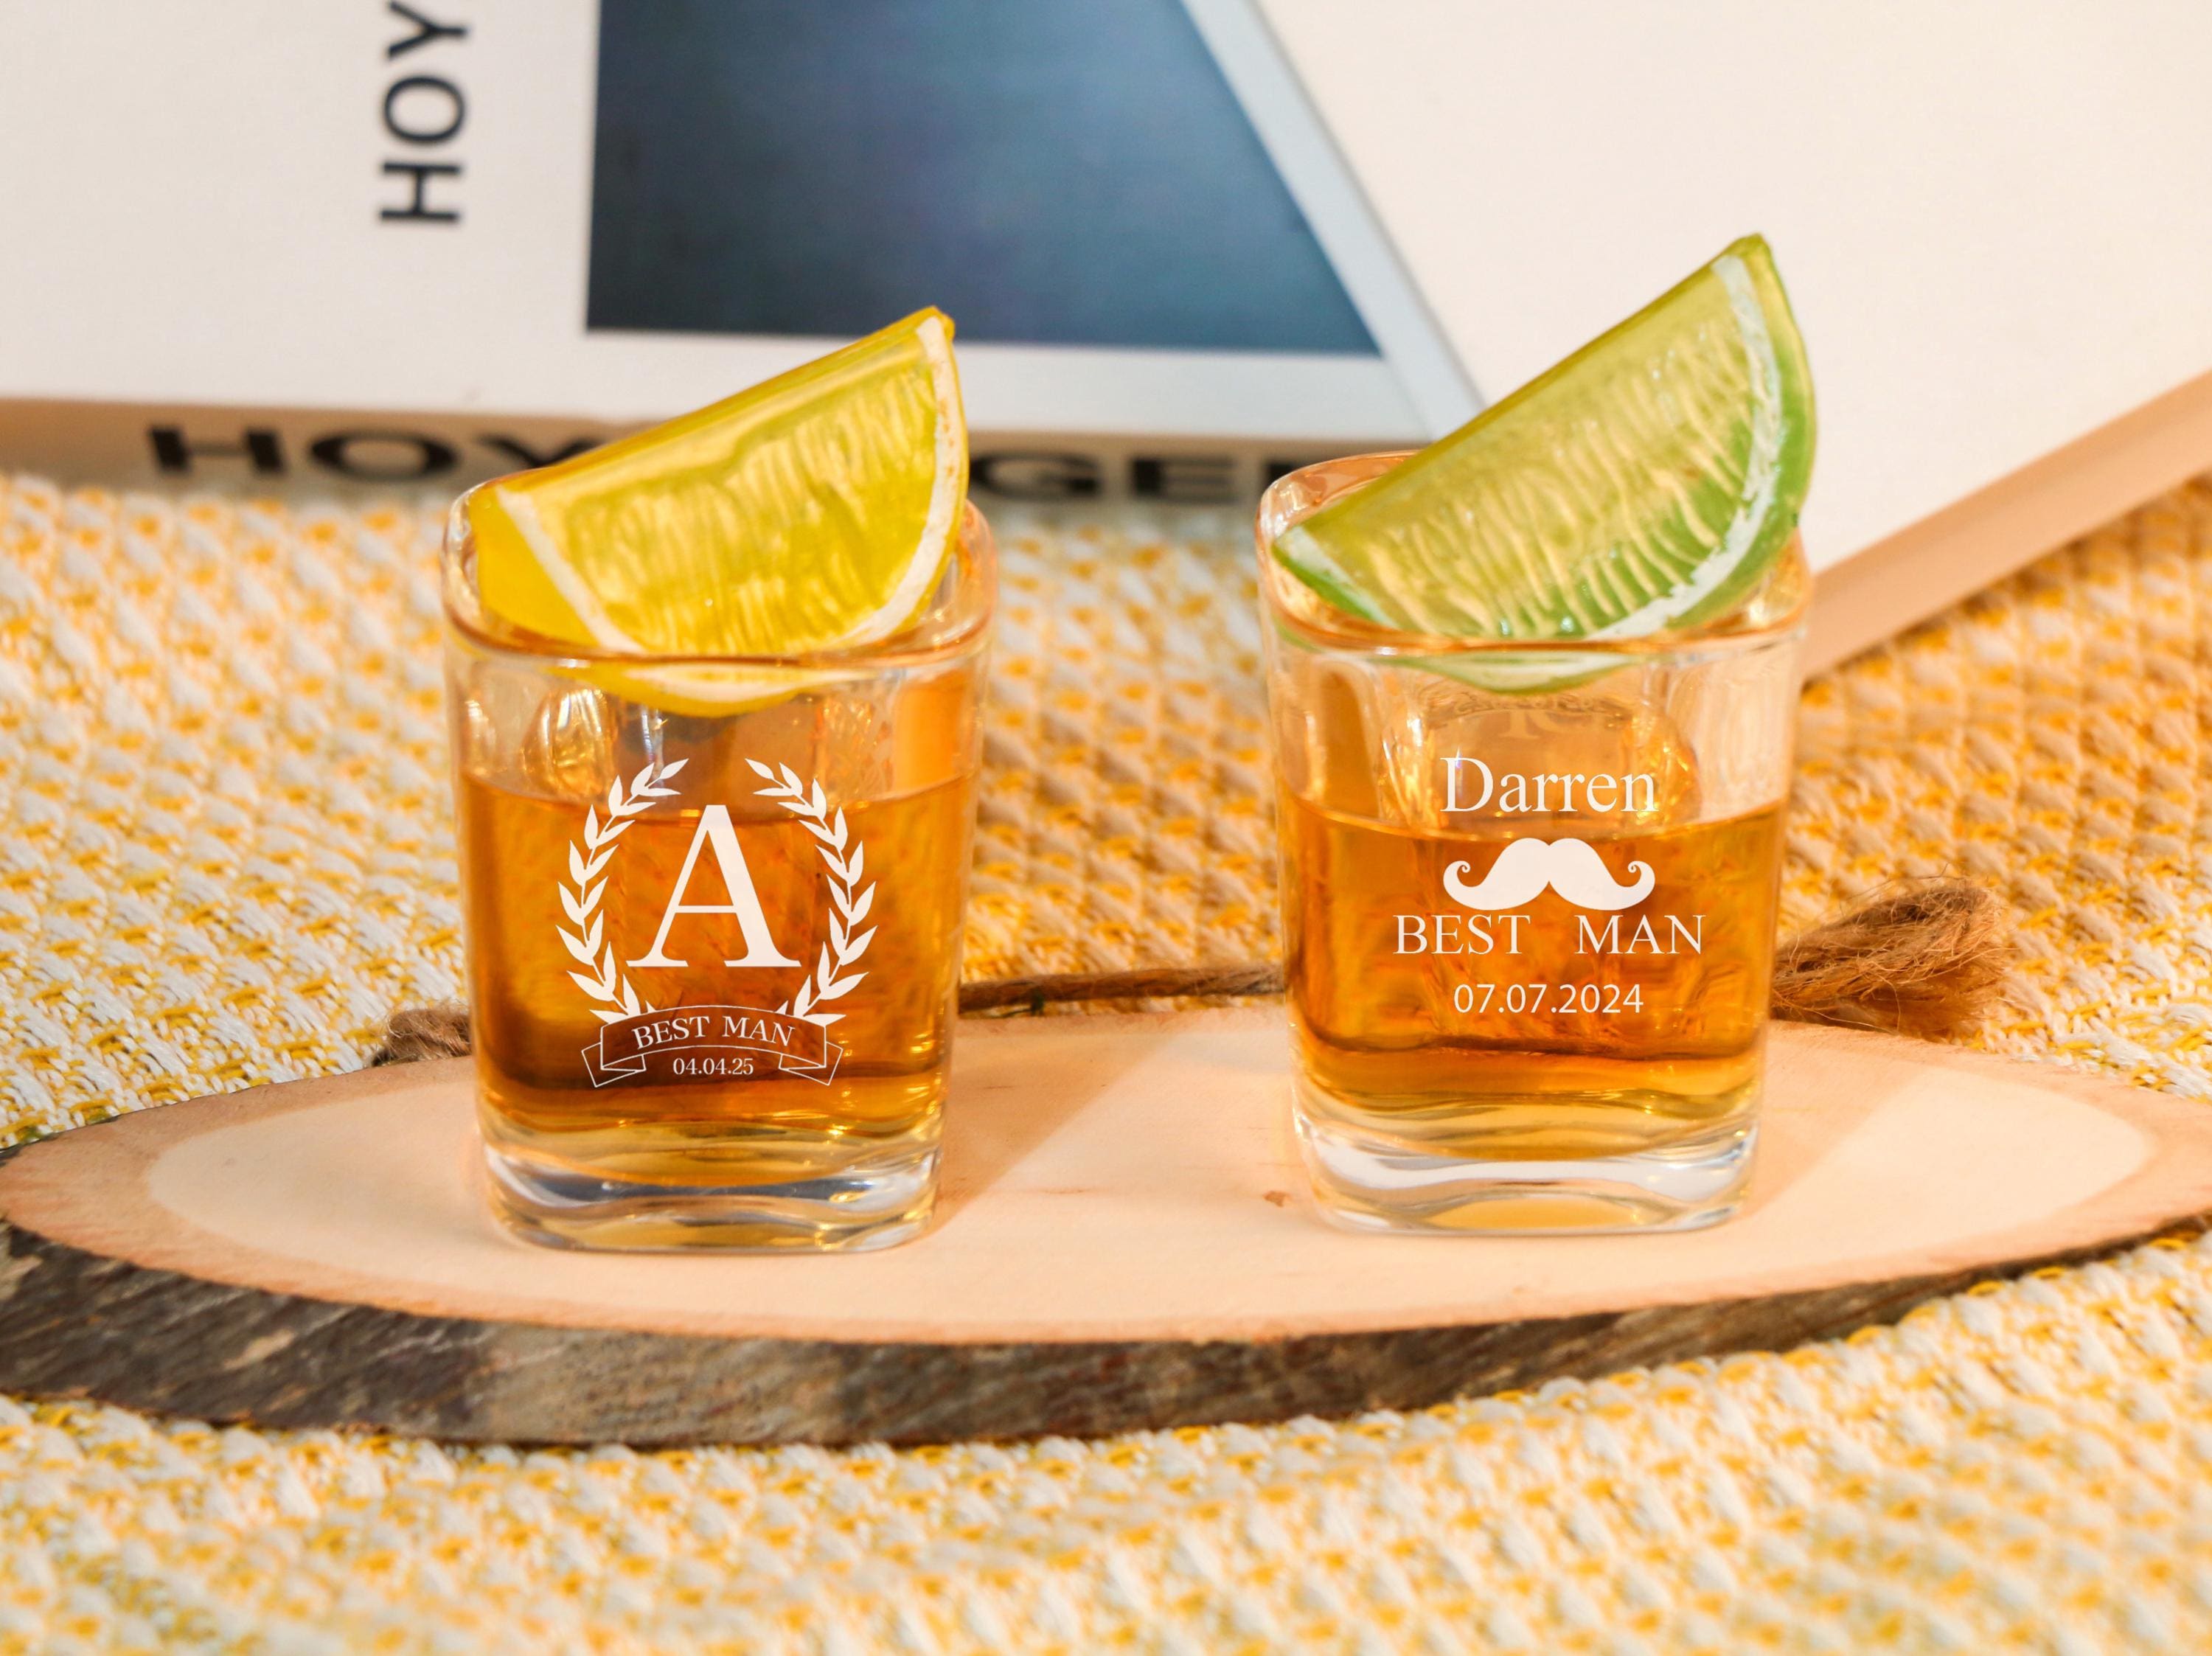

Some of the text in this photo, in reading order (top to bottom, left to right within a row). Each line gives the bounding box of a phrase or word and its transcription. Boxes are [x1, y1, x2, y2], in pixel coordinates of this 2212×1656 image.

[379, 0, 469, 224] HOY
[1439, 756, 1659, 813] Darren
[625, 804, 802, 968] A
[1391, 914, 1707, 956] BEST MAN
[1453, 983, 1644, 1015] 07.07.2024
[631, 1015, 796, 1050] BEST MAN
[672, 1057, 754, 1076] 04.04.25
